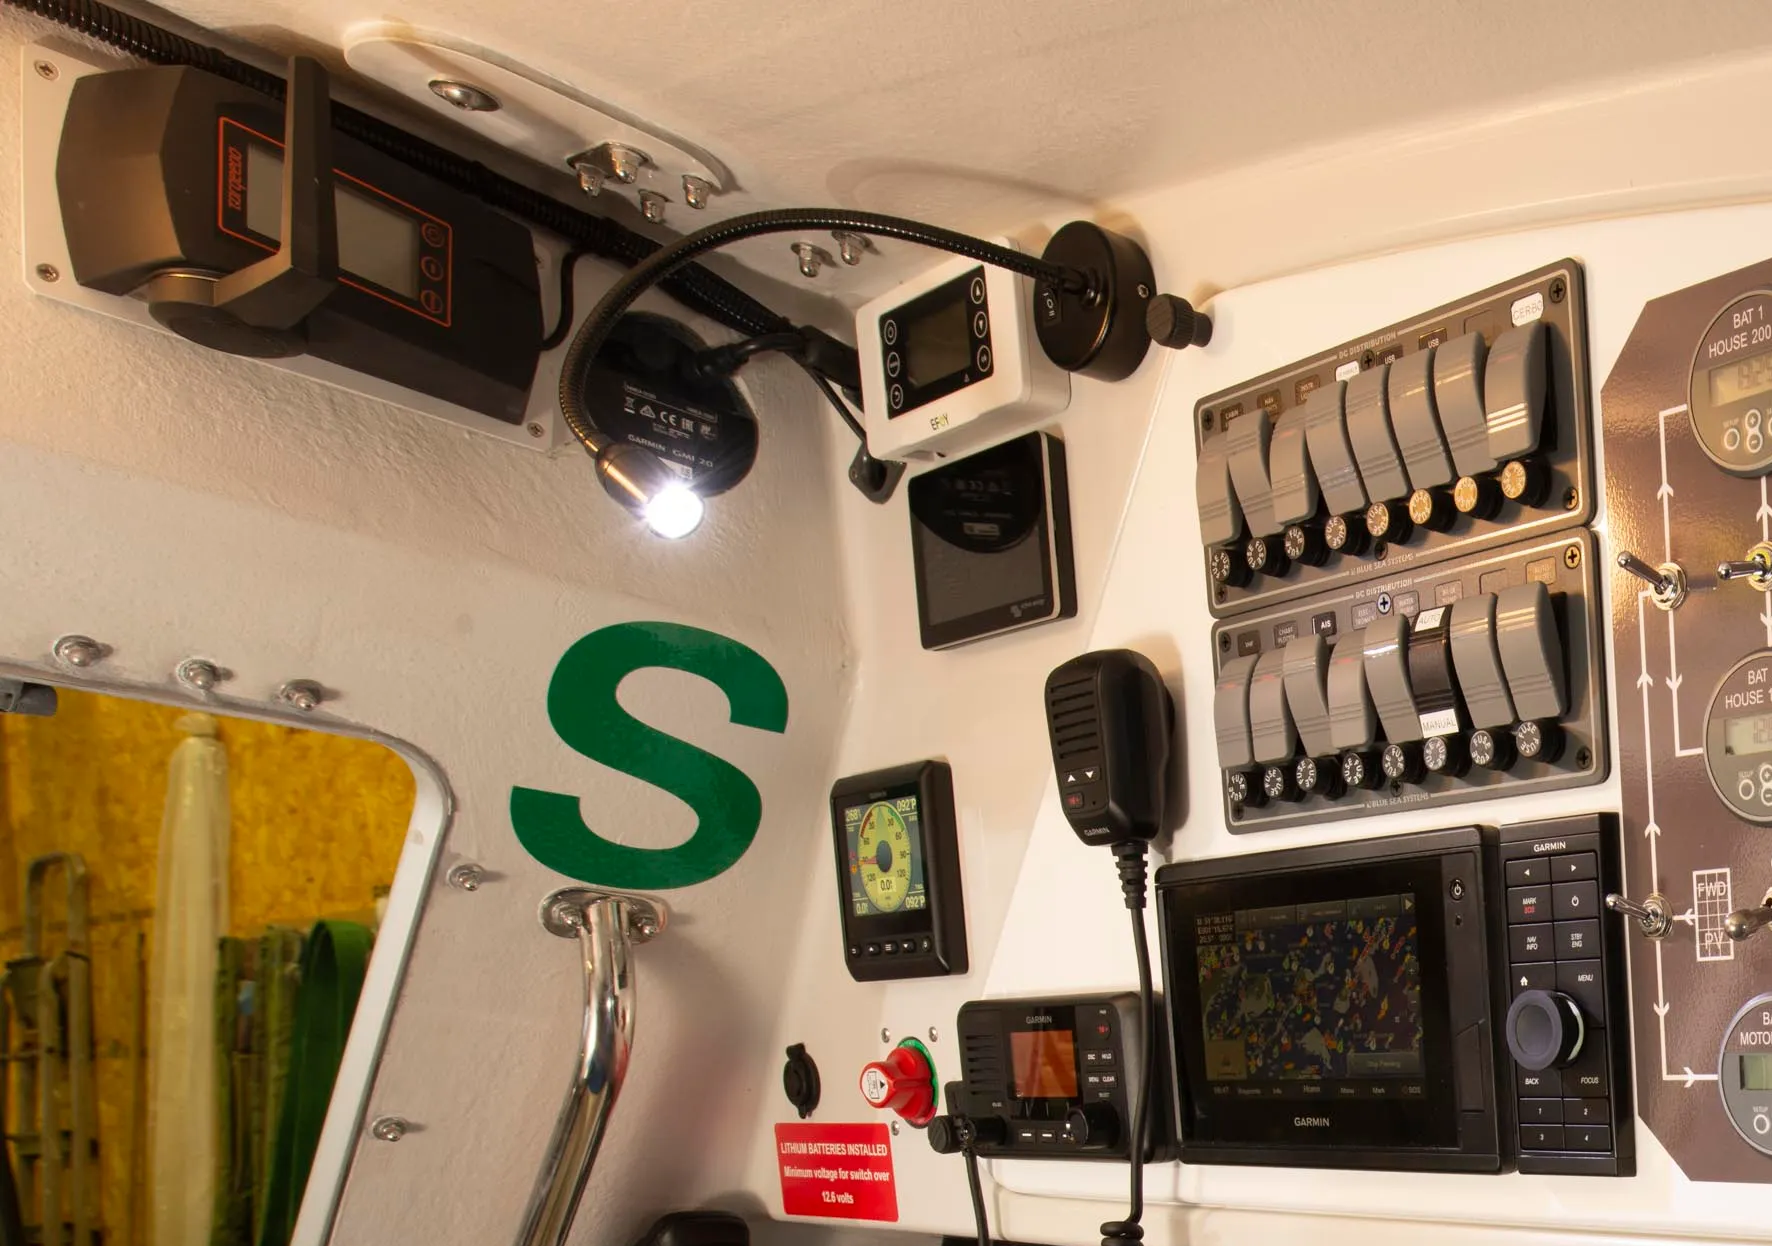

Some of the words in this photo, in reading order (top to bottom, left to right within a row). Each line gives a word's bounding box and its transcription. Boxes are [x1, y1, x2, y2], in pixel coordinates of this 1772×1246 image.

[1512, 300, 1542, 322] CERBO
[1733, 308, 1754, 329] BAT
[1758, 305, 1763, 320] 1
[1350, 332, 1396, 356] DISTRIBUTION
[1428, 337, 1440, 348] USB
[1708, 332, 1748, 358] HOUSE
[1752, 324, 1772, 344] 200
[1384, 353, 1395, 364] USB
[930, 414, 949, 430] EFOY
[627, 433, 666, 451] GARMIN
[1366, 579, 1412, 596] DISTRIBUTION
[1321, 620, 1332, 630] AIS
[1418, 613, 1441, 624] AUTO
[1748, 668, 1768, 685] BAT
[1725, 689, 1764, 709] HOUSE
[1422, 718, 1457, 731] MANUAL
[509, 620, 789, 890] S
[1402, 792, 1429, 803] SYSTEMS
[1533, 841, 1567, 852] GARMIN
[1697, 881, 1727, 898] FWD
[1522, 897, 1536, 905] MARK
[1571, 933, 1583, 941] STBY
[1704, 931, 1724, 950] PV
[1571, 940, 1583, 948] ENG
[1577, 974, 1594, 982] MENU
[1025, 1015, 1052, 1024] GARMIN
[1580, 1076, 1599, 1085] FOCUS
[1294, 1117, 1330, 1127] GARMIN
[781, 1142, 808, 1154] LITHIUM
[809, 1143, 846, 1155] BATTERIES
[847, 1143, 887, 1156] INSTALLED
[784, 1166, 813, 1178] Minimum
[814, 1167, 837, 1182] voltage
[839, 1167, 849, 1179] for
[850, 1168, 872, 1180] switch
[873, 1172, 890, 1181] over
[822, 1191, 836, 1203] 12.6
[836, 1192, 854, 1204] volts
